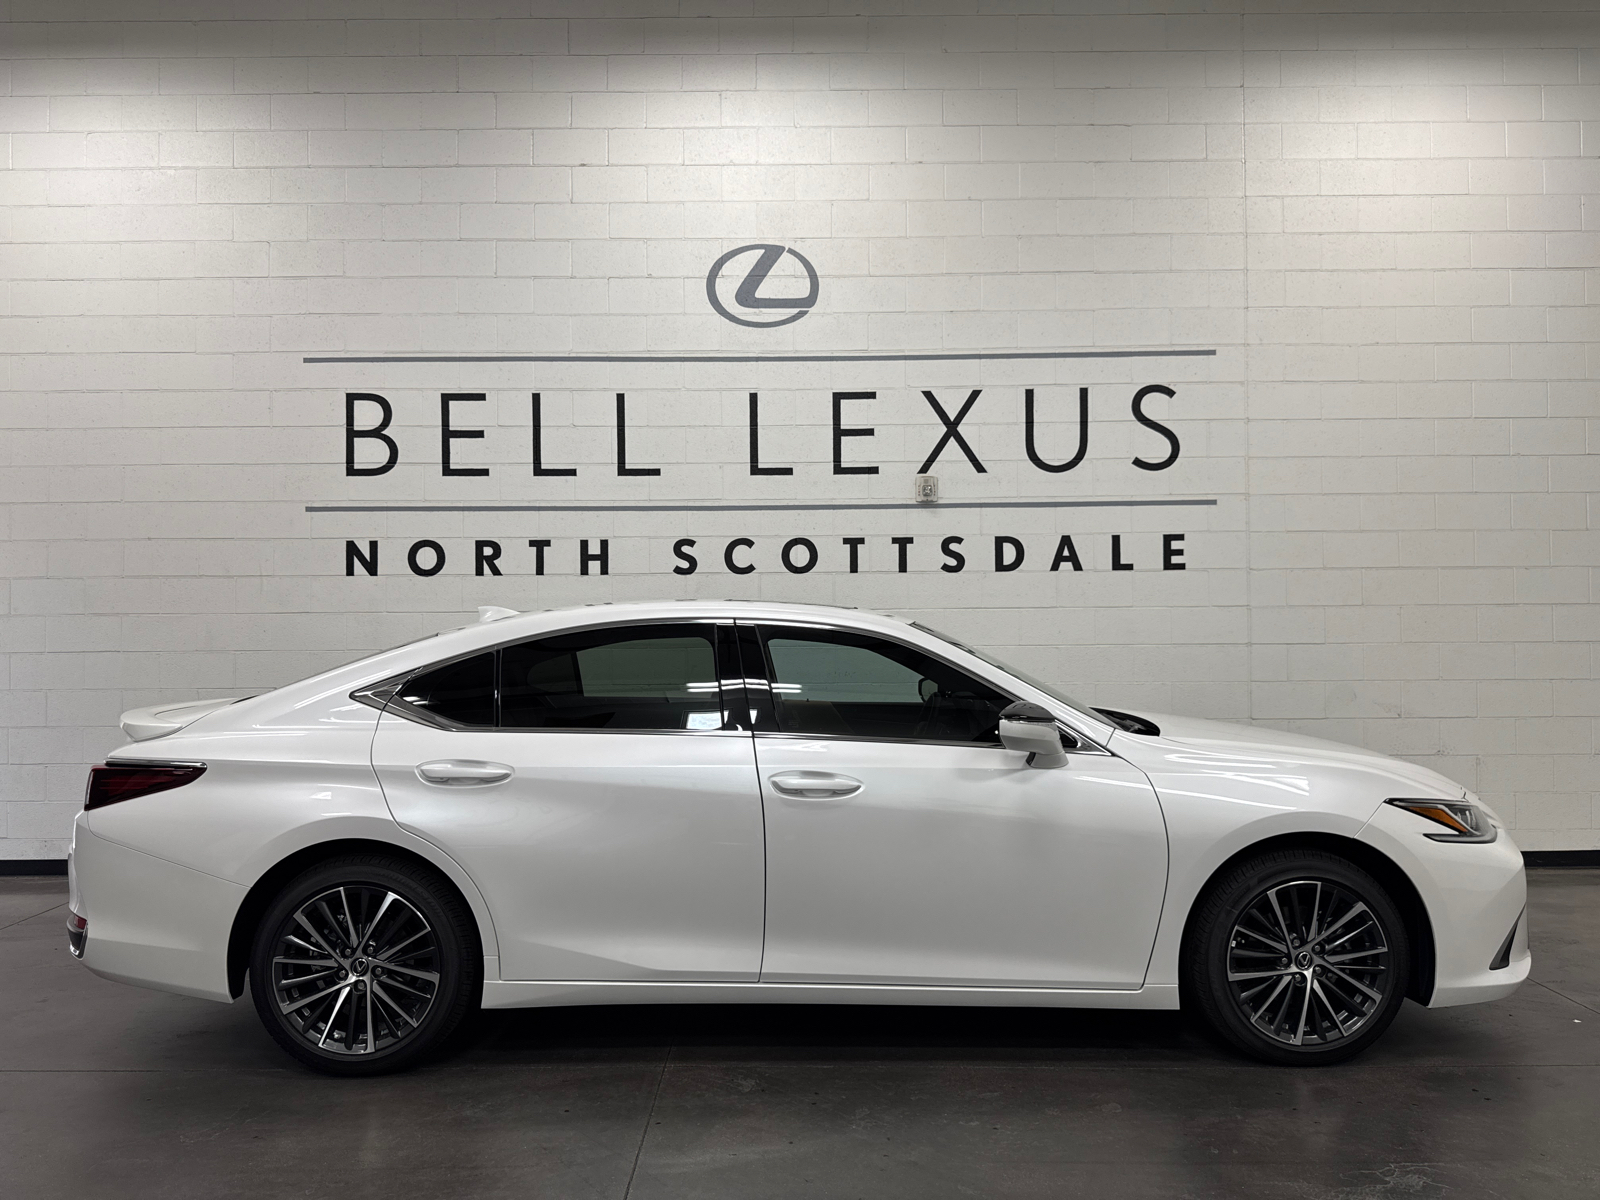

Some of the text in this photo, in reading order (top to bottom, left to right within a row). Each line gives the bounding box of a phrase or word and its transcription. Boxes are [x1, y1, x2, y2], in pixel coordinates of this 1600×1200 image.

[345, 384, 1181, 477] BELL LEXUS
[345, 533, 1187, 578] NORTH SCOTTSDALE
